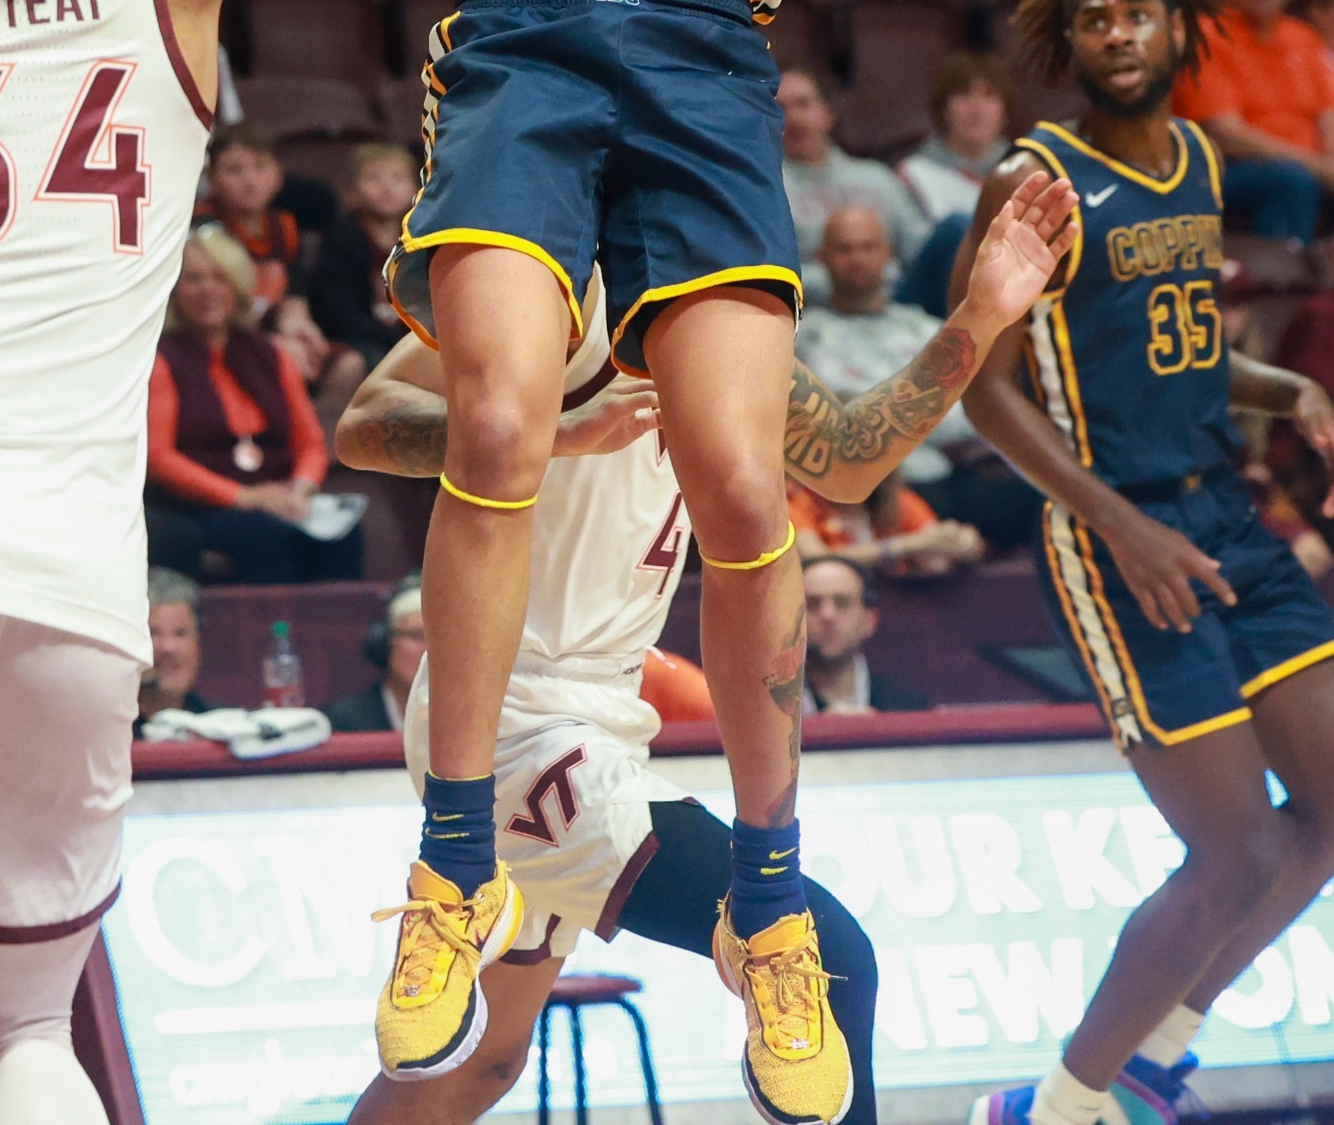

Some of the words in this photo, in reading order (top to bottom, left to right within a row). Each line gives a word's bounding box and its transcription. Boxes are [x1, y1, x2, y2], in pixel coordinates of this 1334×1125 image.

[1106, 214, 1224, 283] COPPI
[1147, 279, 1223, 376] 35
[635, 488, 685, 601] 4
[504, 743, 588, 848] VT
